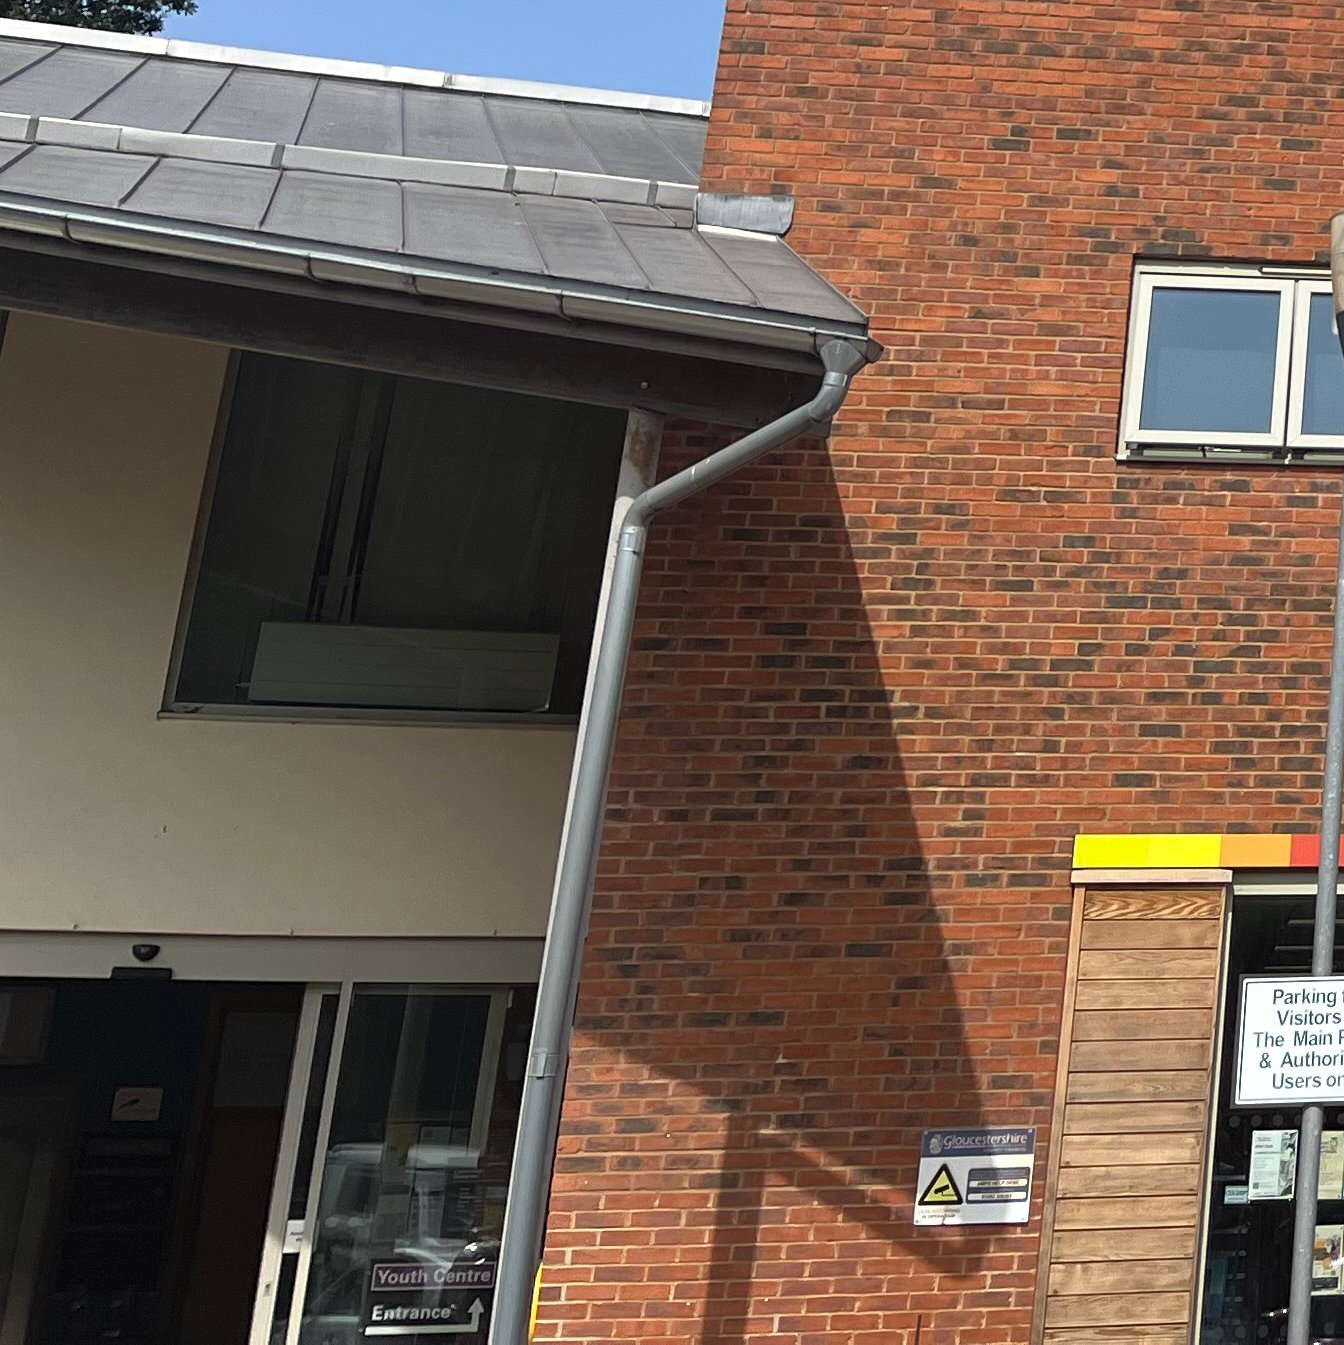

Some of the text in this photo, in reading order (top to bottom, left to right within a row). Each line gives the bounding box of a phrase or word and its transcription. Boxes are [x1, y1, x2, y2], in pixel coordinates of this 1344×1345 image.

[1273, 988, 1337, 1007] Parking
[1277, 1009, 1341, 1026] Visitors
[1253, 1031, 1285, 1048] The
[1293, 1029, 1333, 1046] Main
[1259, 1052, 1271, 1069] &
[1272, 1072, 1322, 1089] Users
[943, 1133, 1027, 1149] Gloucestershire
[378, 1269, 491, 1284] Youth Centre
[371, 1304, 451, 1321] Entrance
